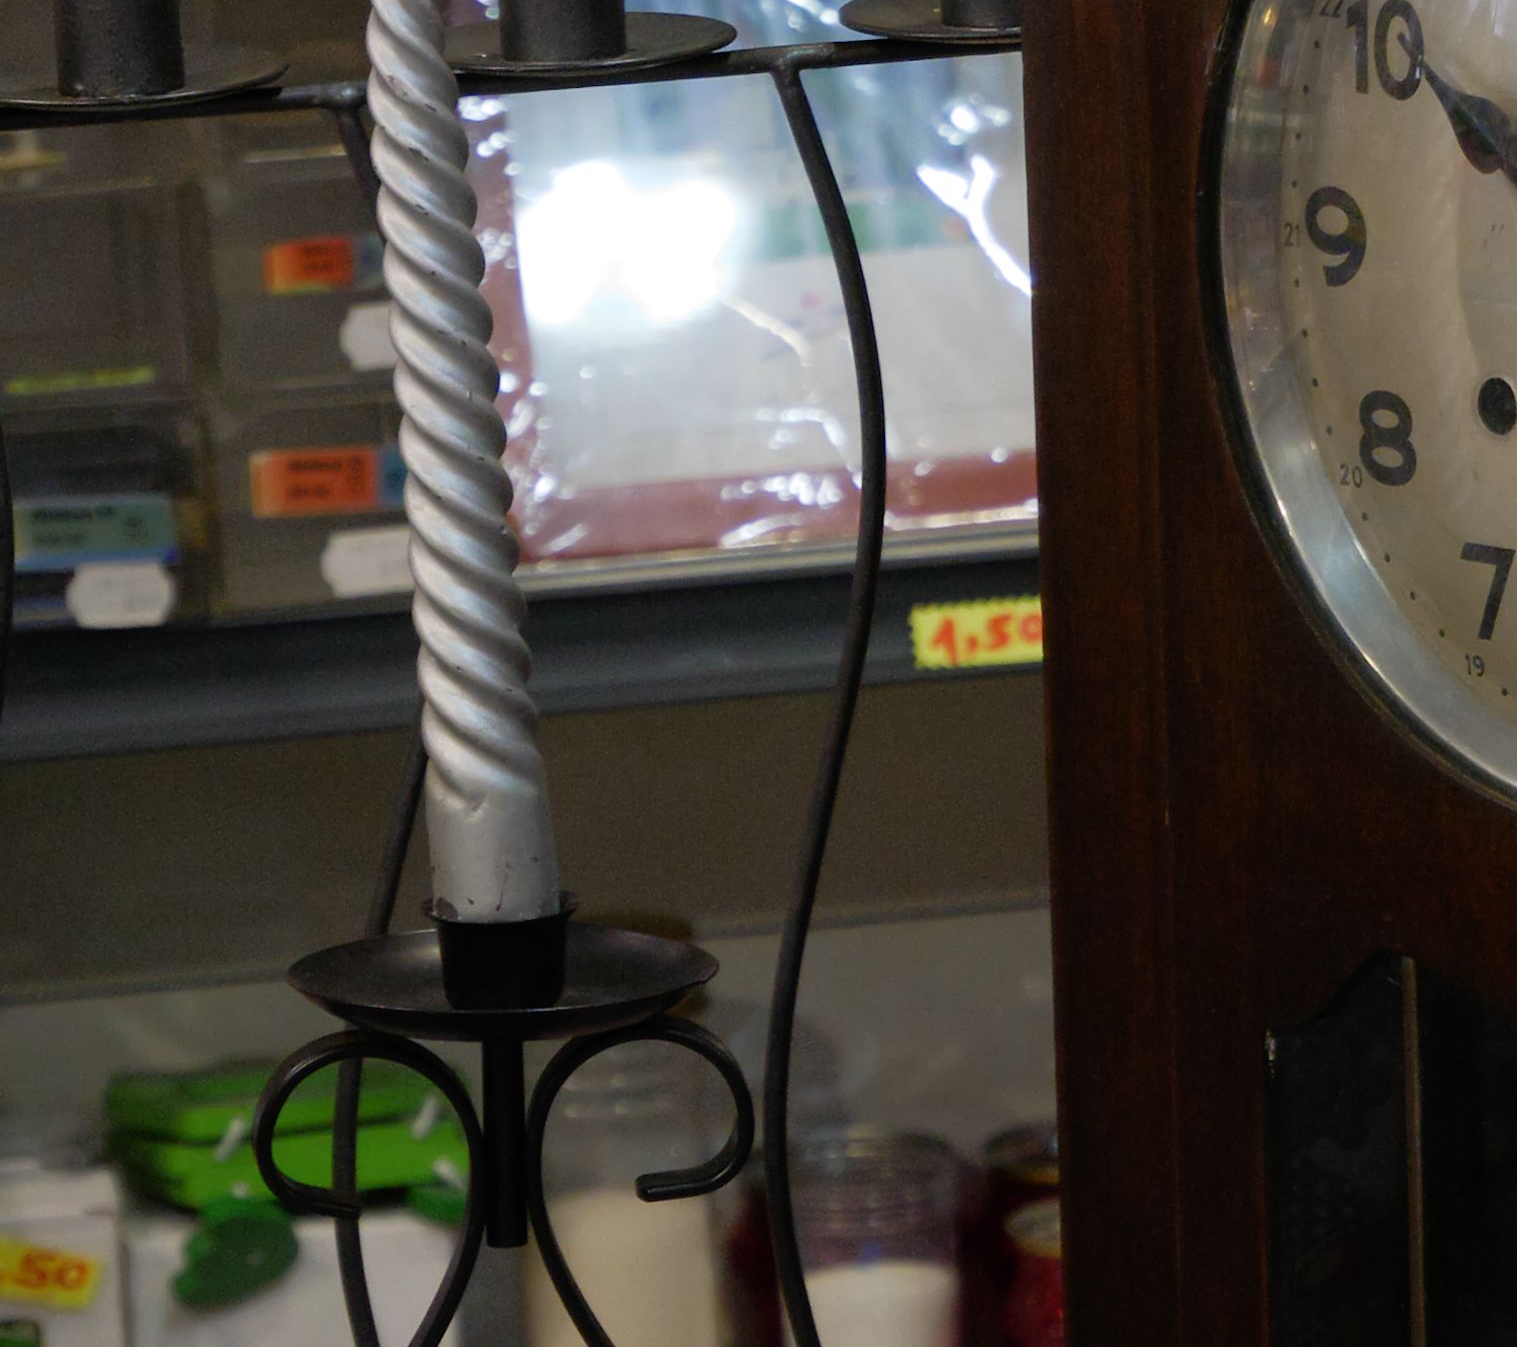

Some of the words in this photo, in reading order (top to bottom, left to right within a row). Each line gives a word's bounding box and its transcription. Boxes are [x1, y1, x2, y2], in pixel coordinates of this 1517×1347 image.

[1284, 222, 1301, 248] 21
[1305, 186, 1367, 288] 9
[1359, 390, 1417, 486] 8
[1339, 463, 1363, 489] 20
[1460, 541, 1517, 641] 7
[1465, 653, 1485, 678] 19
